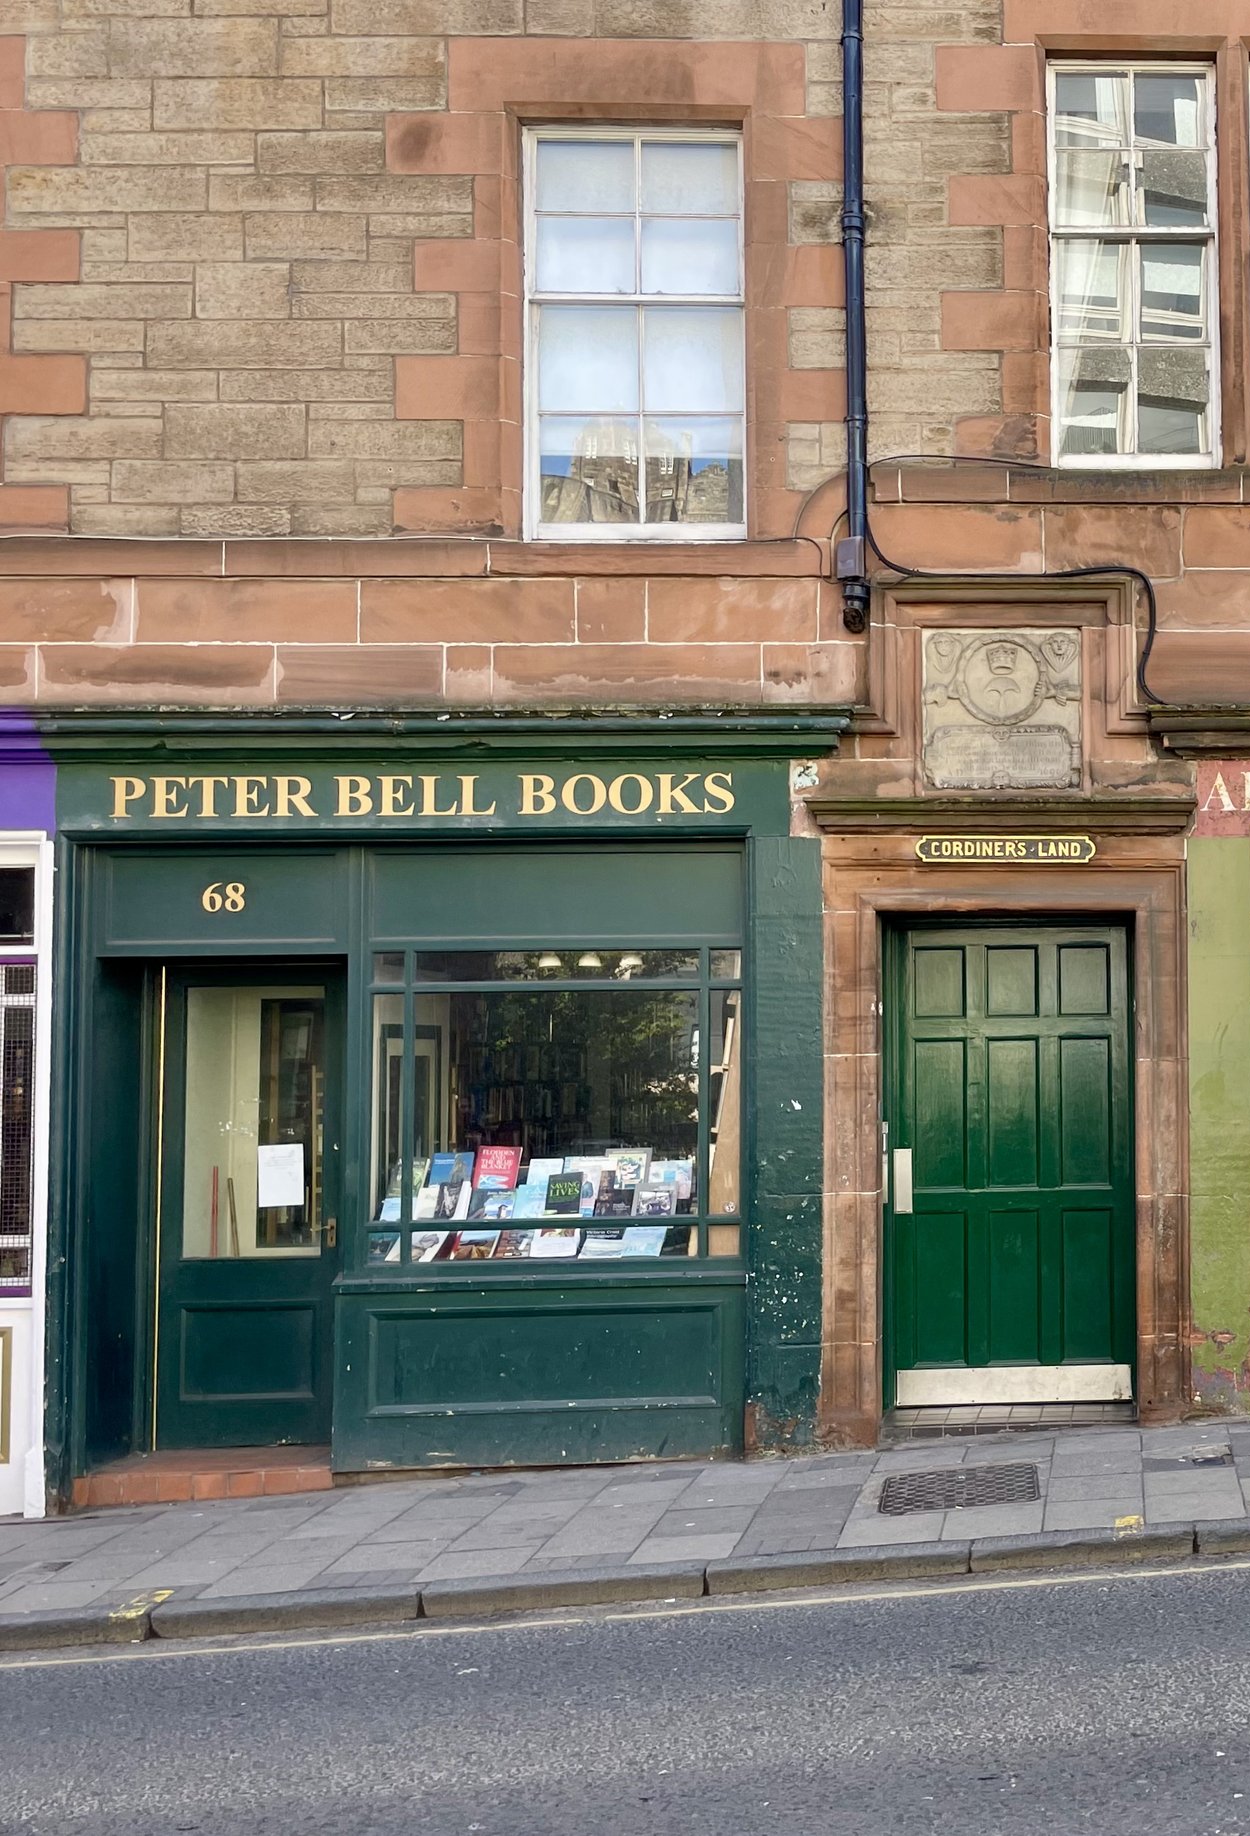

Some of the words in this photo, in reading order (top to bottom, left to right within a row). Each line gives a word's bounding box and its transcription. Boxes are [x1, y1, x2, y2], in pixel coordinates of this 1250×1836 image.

[111, 776, 317, 818] PETER
[335, 775, 496, 817] BELL
[520, 772, 735, 815] BOOKS
[930, 840, 1027, 858] CORDINER'S
[1037, 841, 1081, 857] LAND
[202, 882, 245, 913] 68
[549, 1187, 580, 1197] LIVES
[550, 1180, 580, 1189] SAVING
